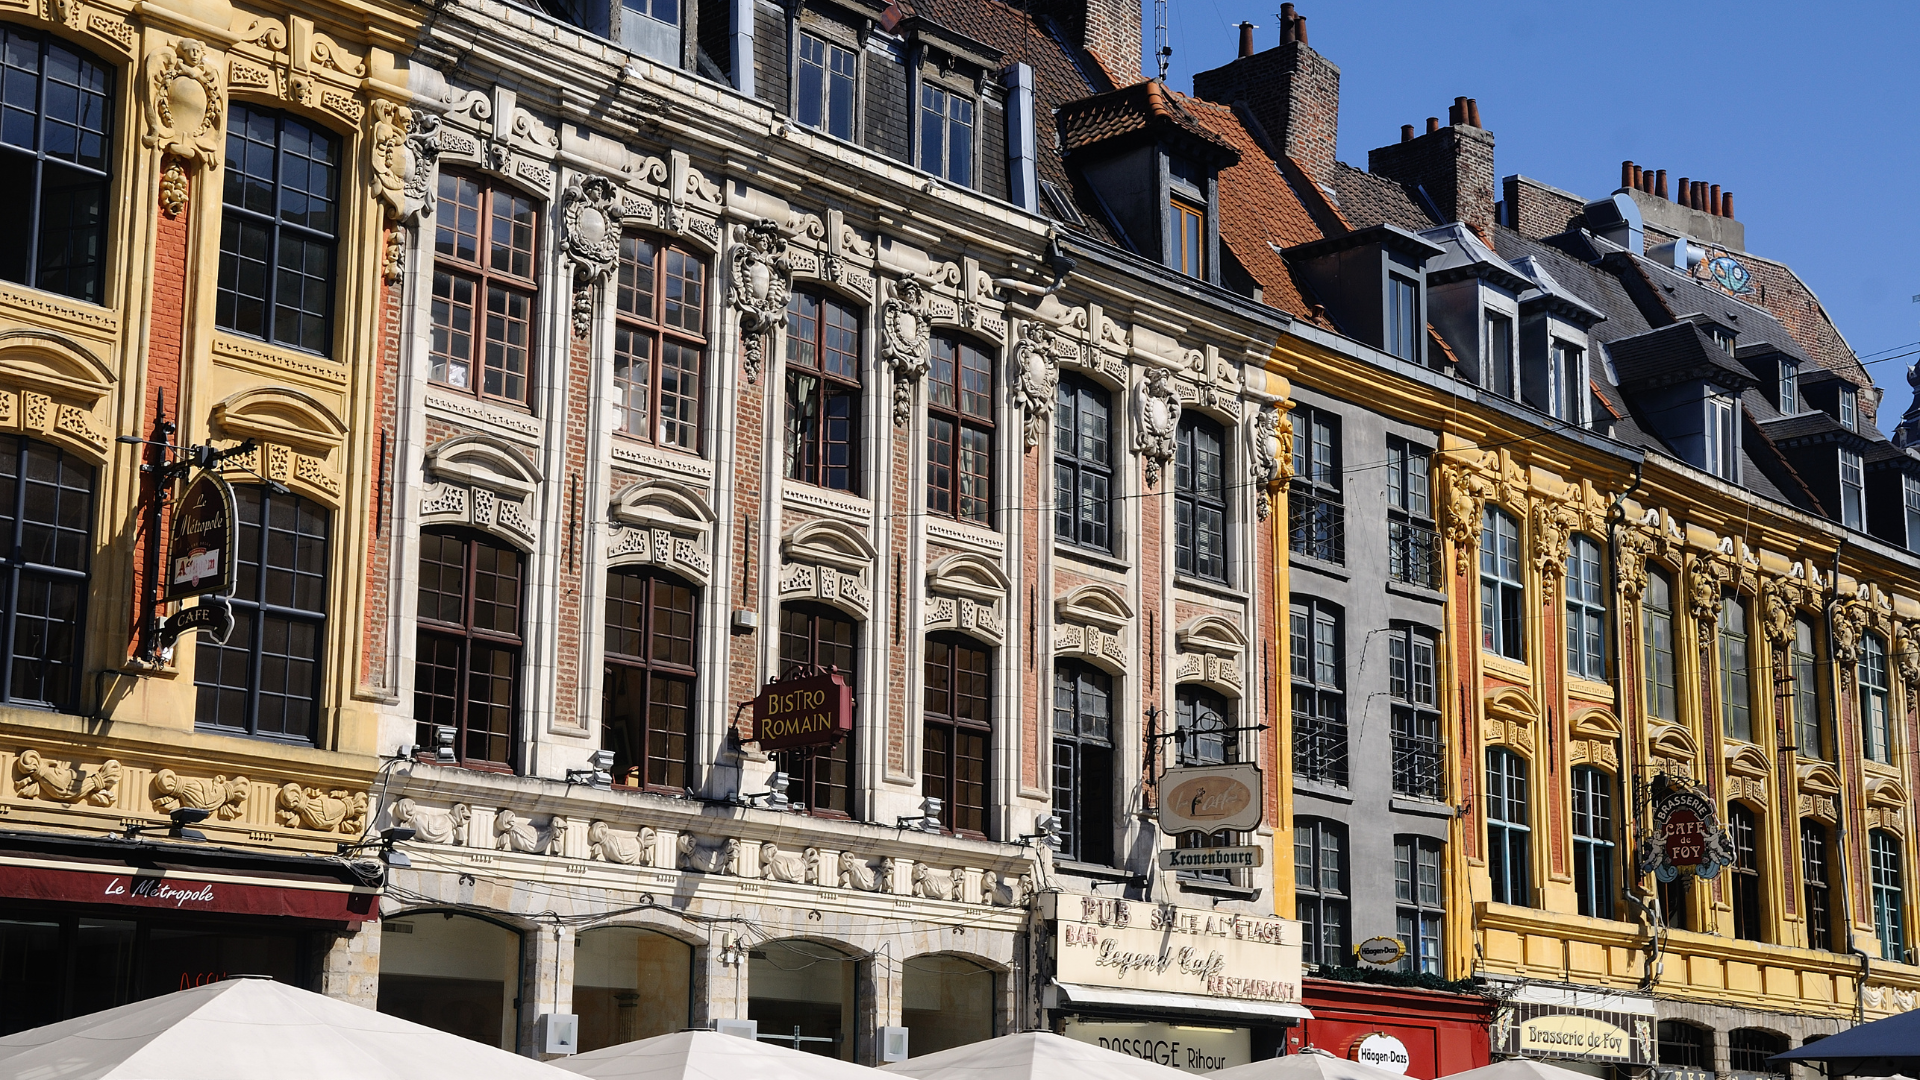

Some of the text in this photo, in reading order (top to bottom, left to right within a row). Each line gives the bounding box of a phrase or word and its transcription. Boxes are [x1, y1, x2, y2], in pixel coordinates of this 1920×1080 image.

[192, 493, 208, 510] Le
[174, 511, 224, 541] Métropole
[768, 690, 825, 715] BISTRO
[761, 712, 832, 740] ROMAIN
[1657, 795, 1708, 820] BRASSERIE
[1672, 845, 1701, 859] FOY
[1680, 836, 1691, 844] de
[1169, 850, 1253, 866] Kronenbourg
[104, 877, 215, 907] Le Métropole
[1081, 896, 1133, 929] PUB
[1066, 924, 1099, 949] BAR
[1095, 938, 1175, 979] Legend
[1207, 975, 1296, 1003] RESTAURANT
[1528, 1026, 1623, 1054] Brasserie de Foy
[1186, 1047, 1227, 1070] Rihour
